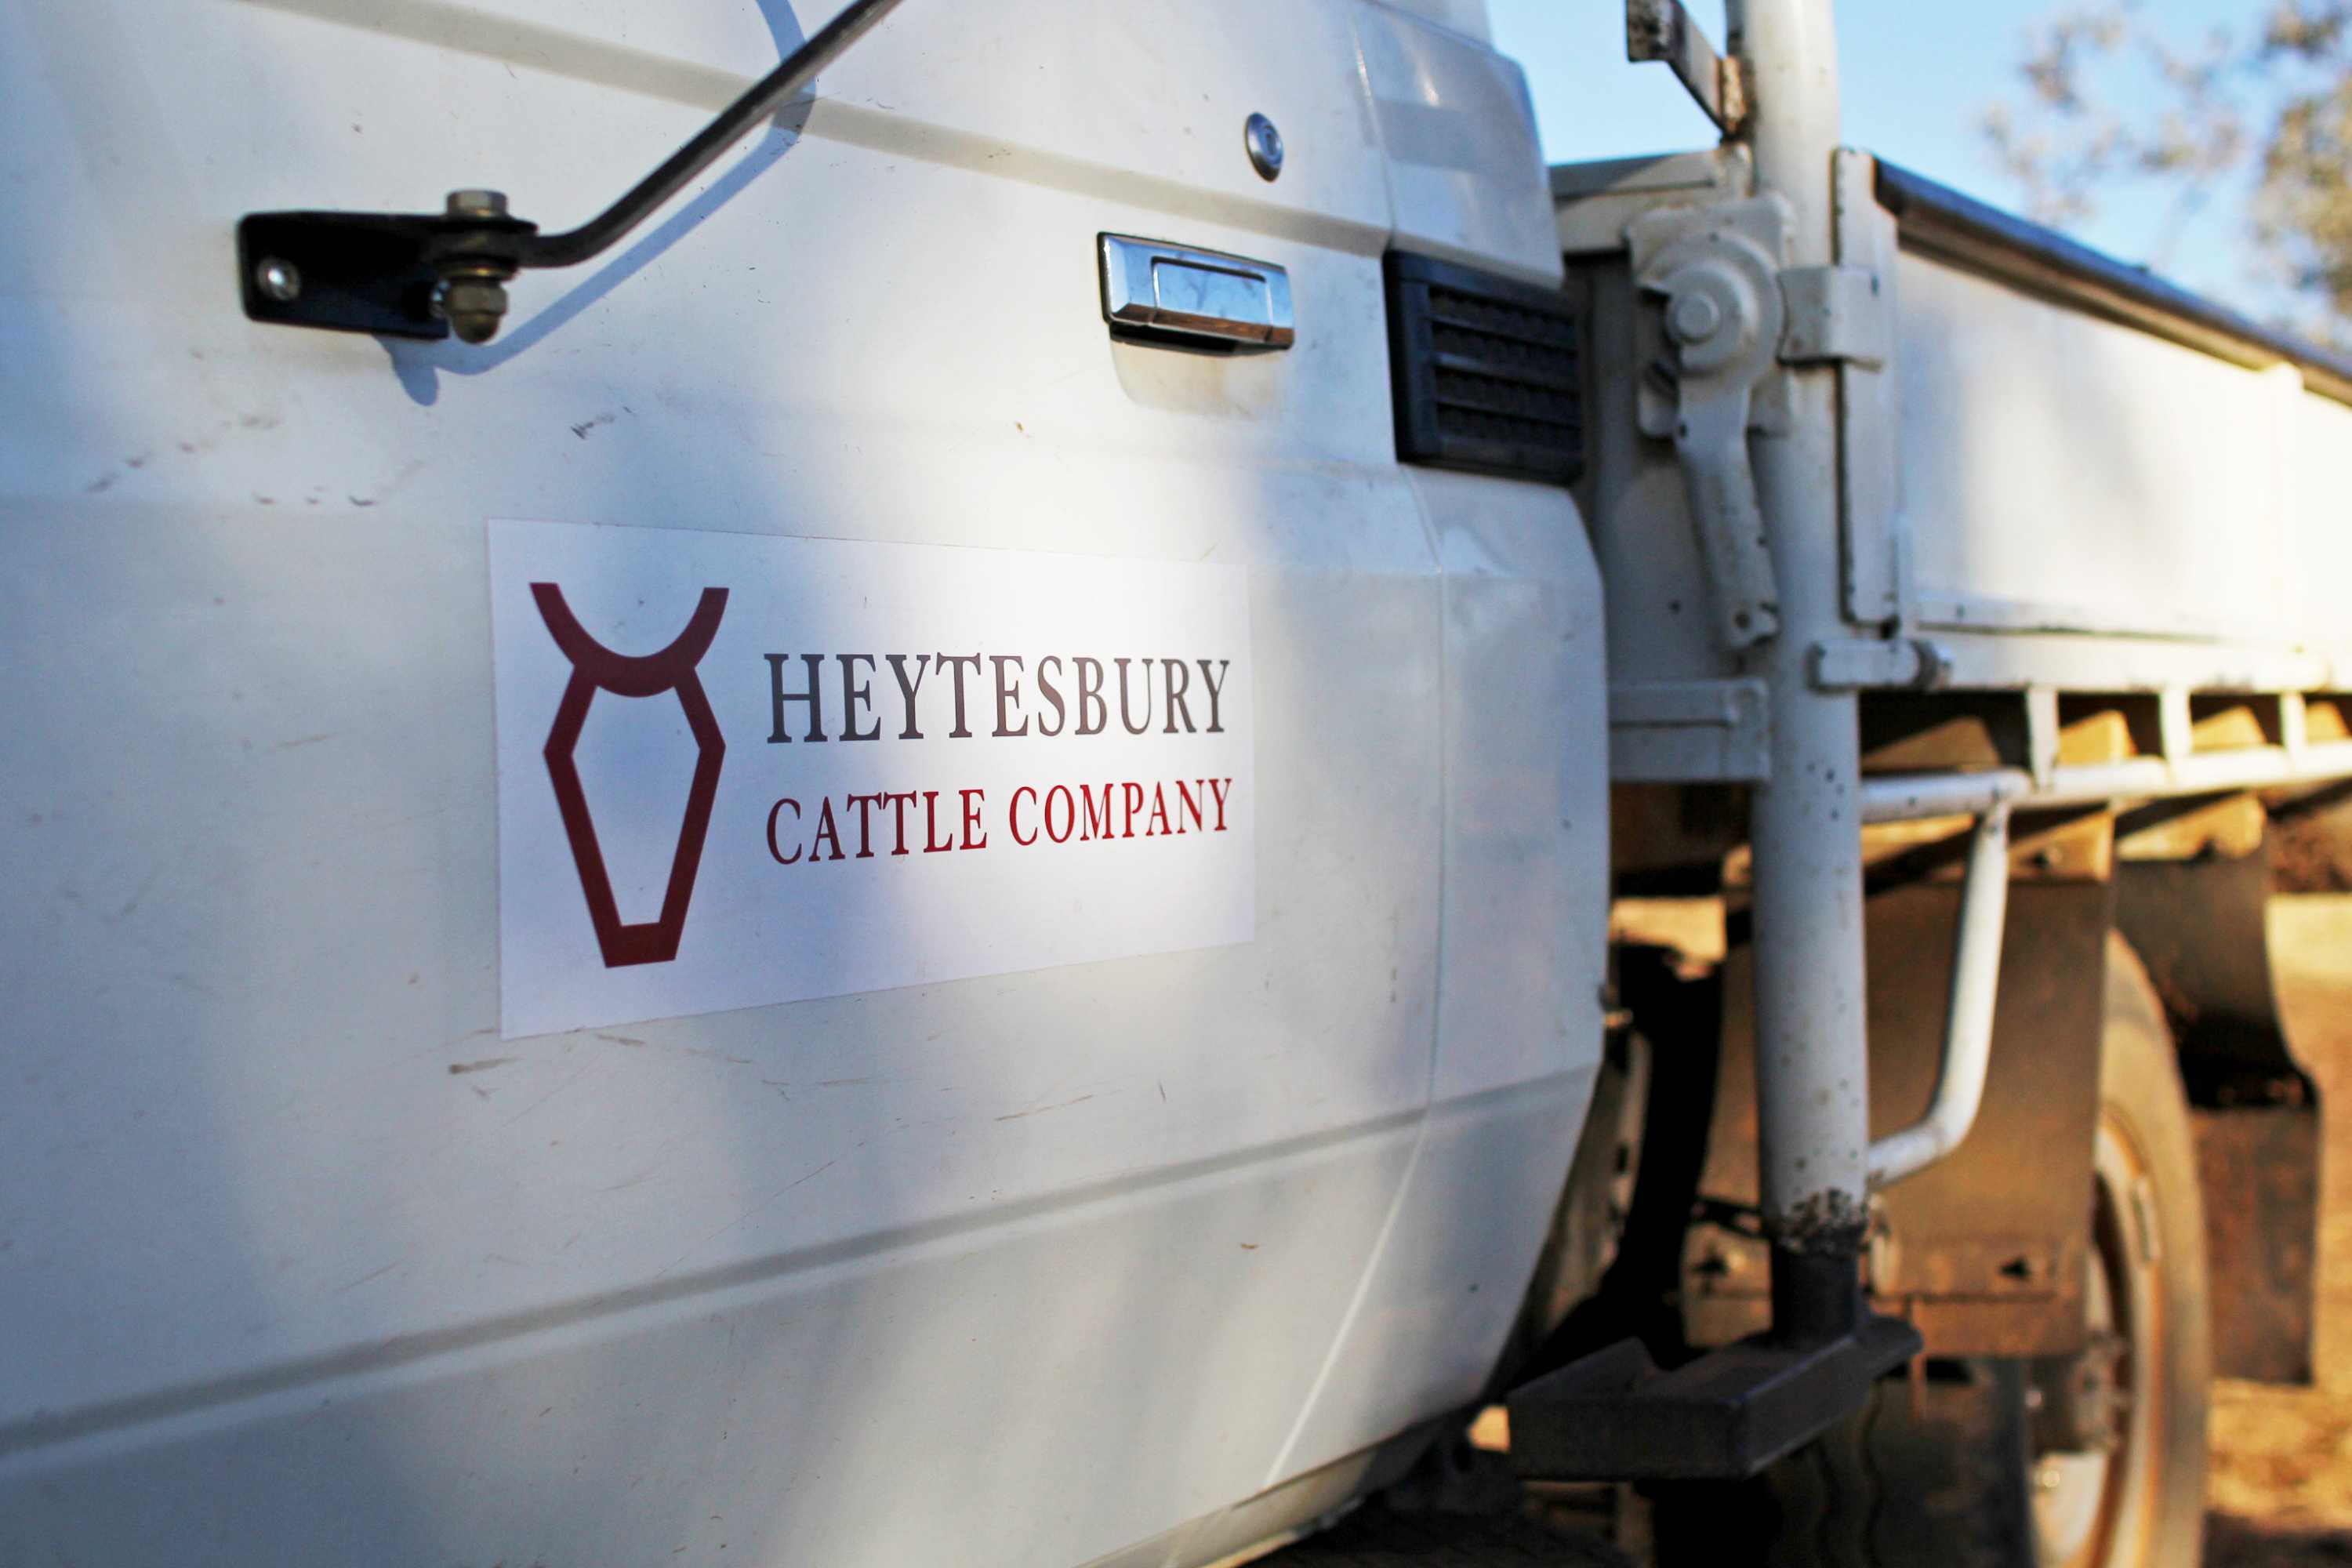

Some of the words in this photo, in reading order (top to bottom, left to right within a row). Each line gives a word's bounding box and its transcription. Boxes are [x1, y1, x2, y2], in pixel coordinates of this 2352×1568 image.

[764, 652, 1230, 744] HEYTESBURY
[766, 788, 988, 866] CATTLE
[1008, 777, 1232, 847] COMPANY
